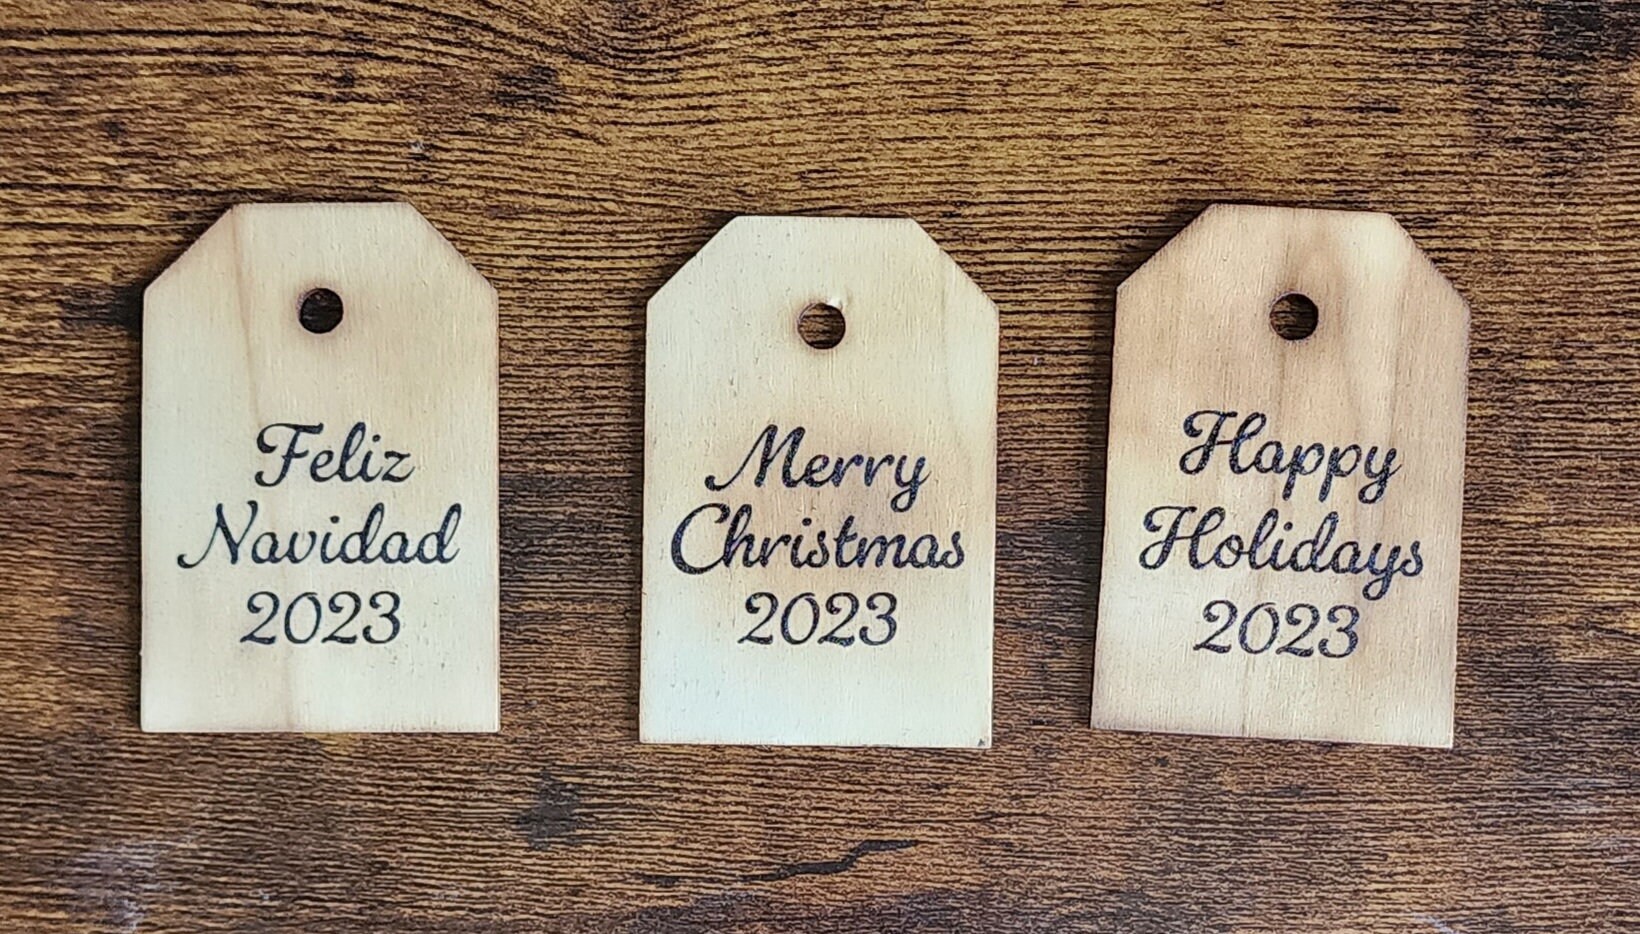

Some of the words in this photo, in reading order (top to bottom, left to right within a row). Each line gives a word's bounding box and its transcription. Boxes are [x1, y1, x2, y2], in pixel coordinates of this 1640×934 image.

[255, 421, 415, 488] Feliz
[704, 423, 930, 513] Merry
[1179, 409, 1403, 505] Happy
[176, 500, 462, 569] Navidad
[670, 502, 965, 575] Christmas
[1139, 505, 1424, 601] Holidays
[239, 590, 401, 645] 2023
[737, 591, 898, 647] 2023
[1192, 600, 1360, 659] 2023
